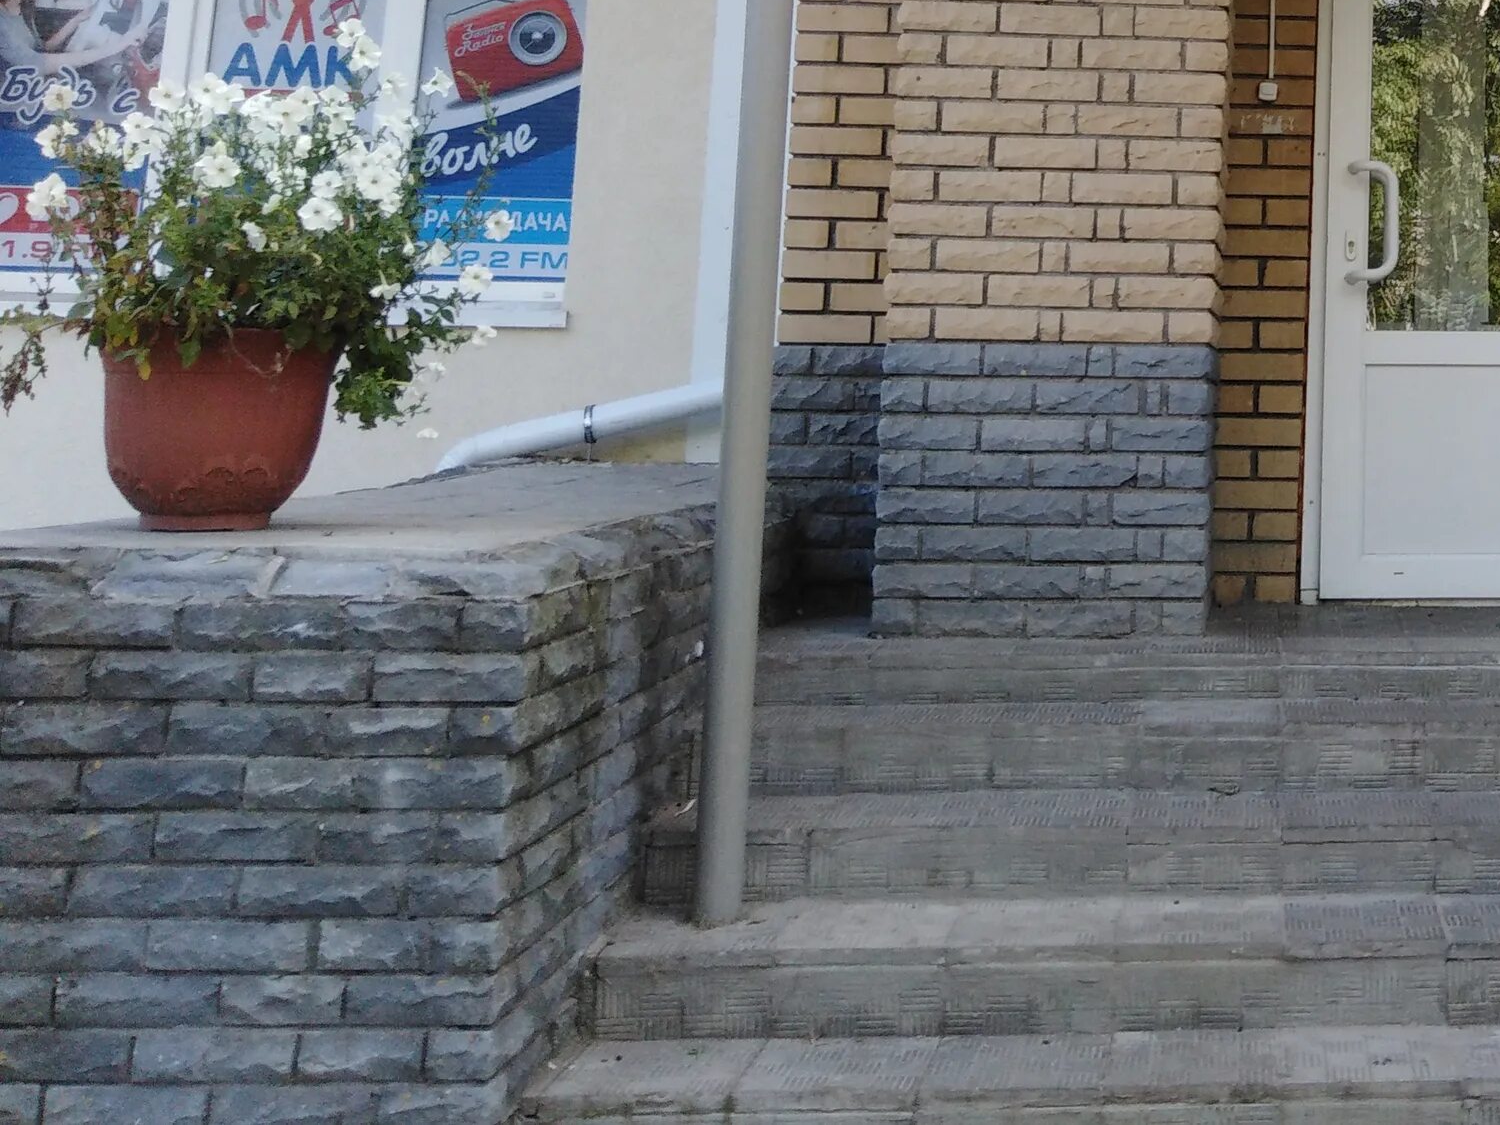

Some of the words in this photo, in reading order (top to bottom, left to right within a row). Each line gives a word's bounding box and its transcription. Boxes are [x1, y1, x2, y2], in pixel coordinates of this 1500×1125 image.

[454, 35, 504, 57] Radio
[222, 42, 356, 88] АМК
[420, 123, 538, 177] волне
[510, 210, 568, 233] ДАЧА
[520, 251, 568, 270] FM
